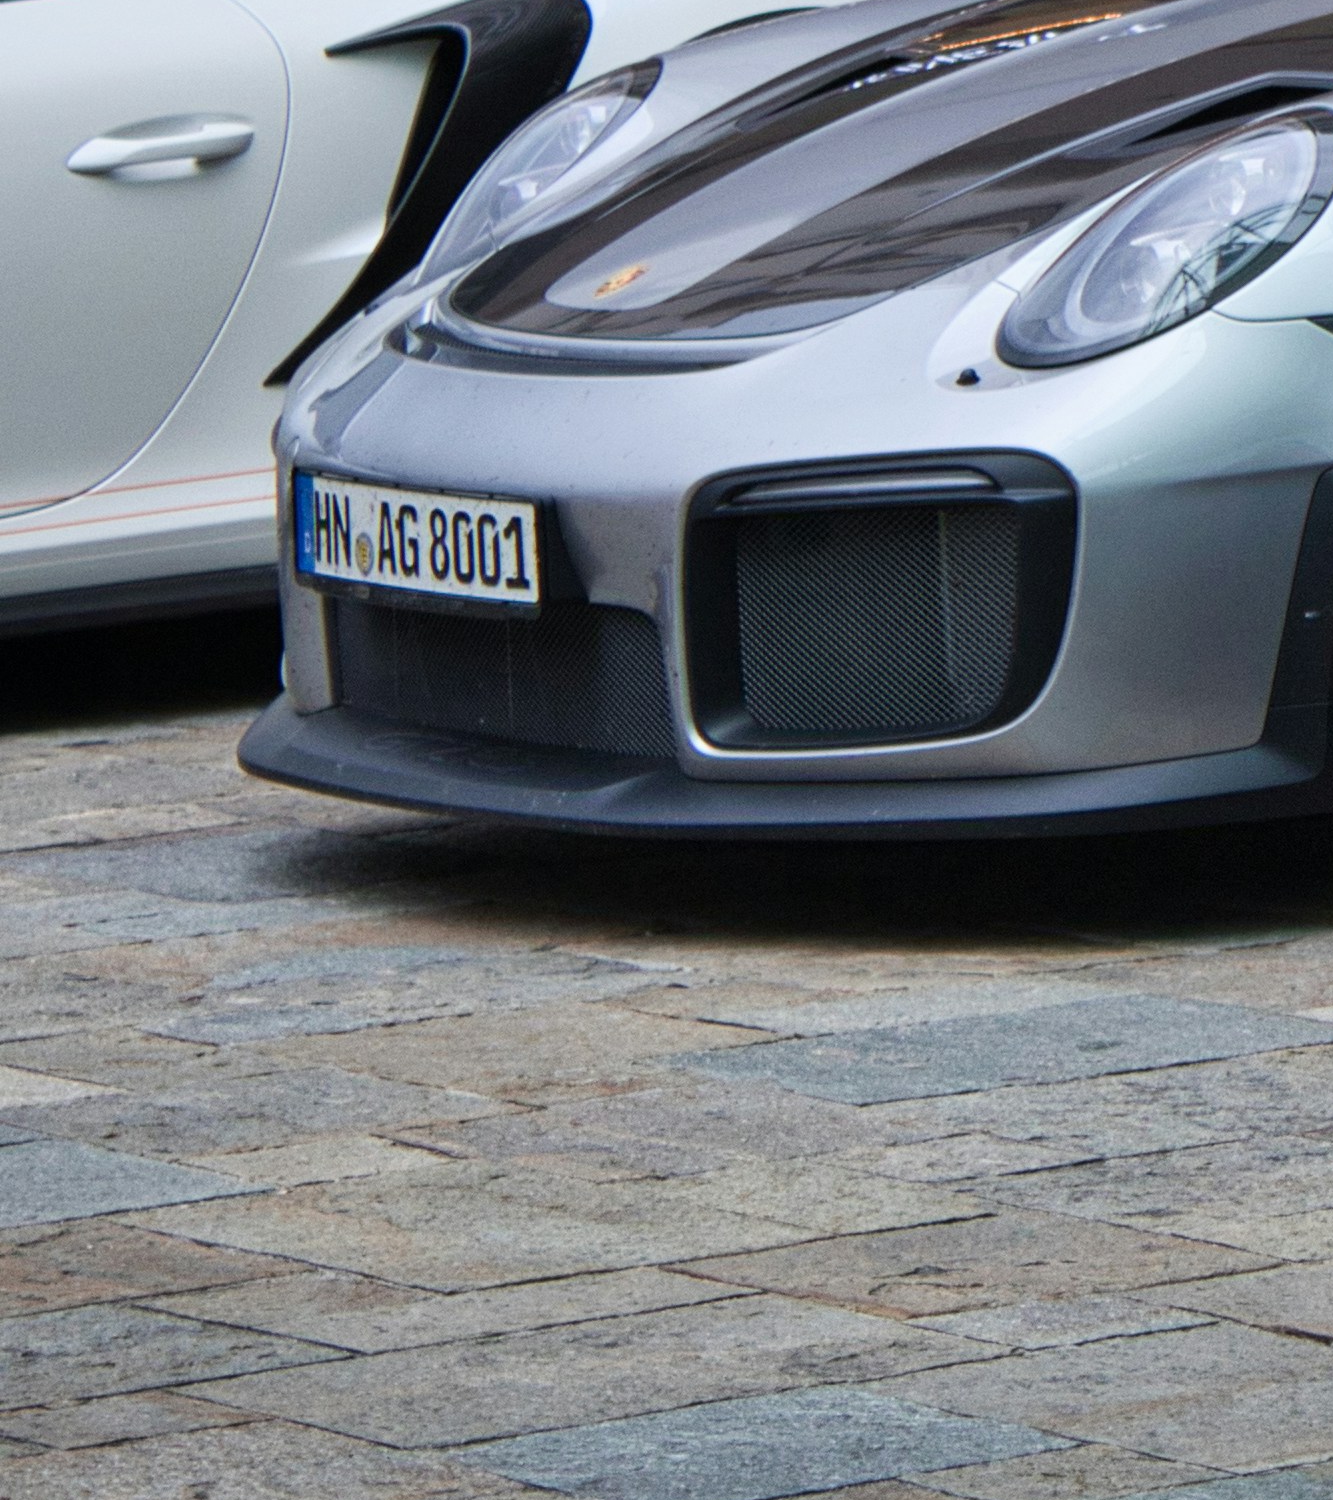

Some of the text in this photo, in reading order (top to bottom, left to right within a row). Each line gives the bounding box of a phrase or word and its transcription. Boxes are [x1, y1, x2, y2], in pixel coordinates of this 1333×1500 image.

[314, 490, 531, 590] HN AG 8001
